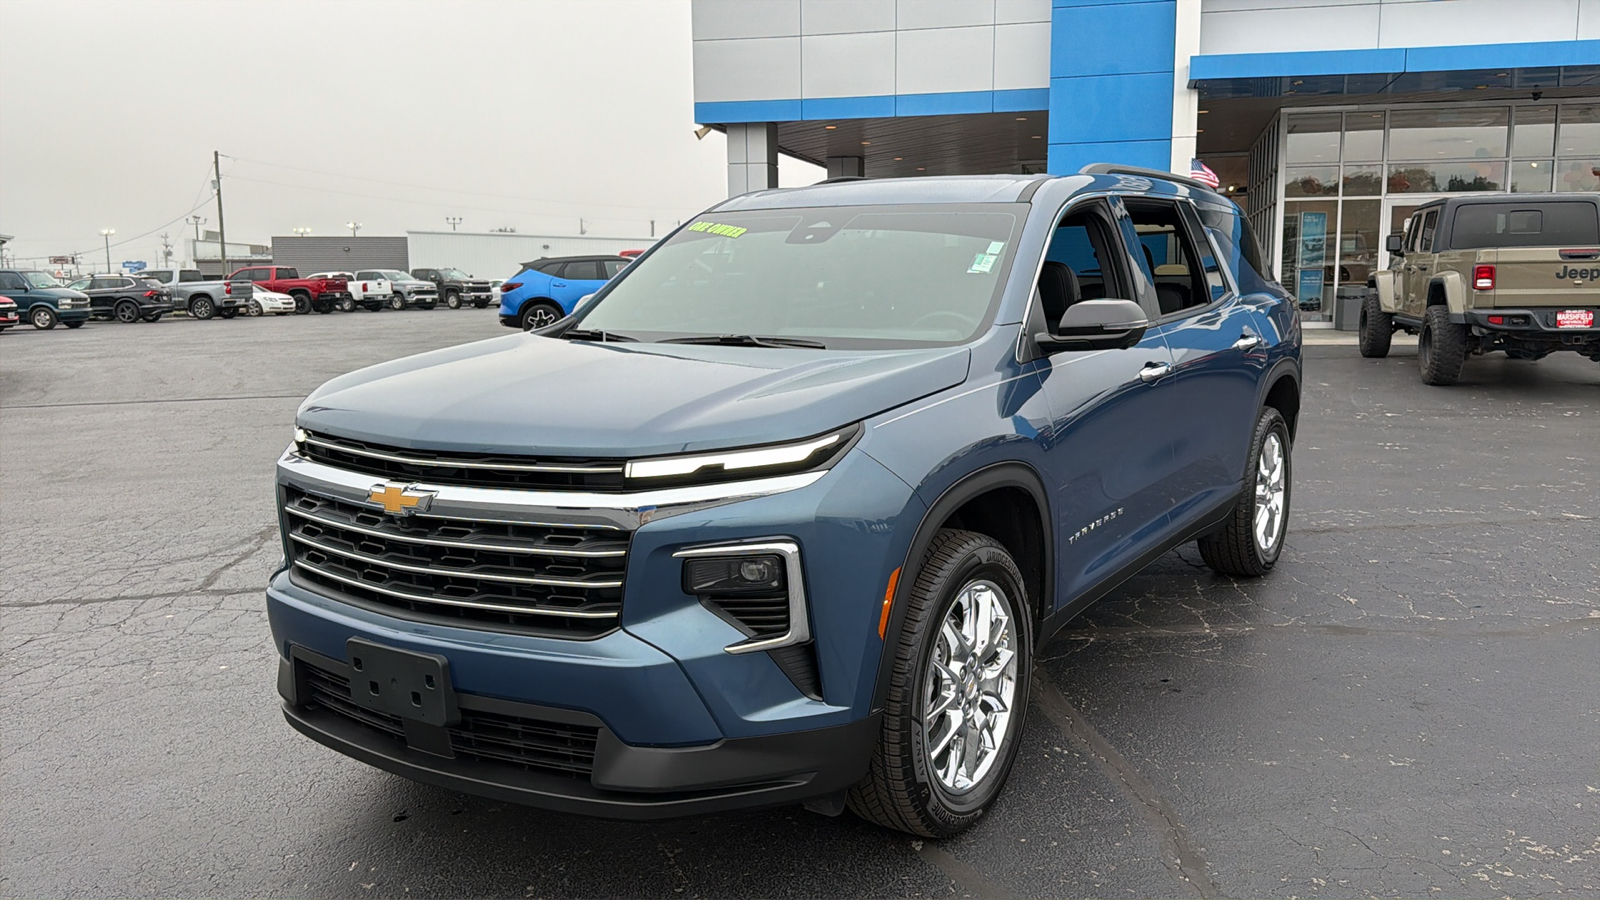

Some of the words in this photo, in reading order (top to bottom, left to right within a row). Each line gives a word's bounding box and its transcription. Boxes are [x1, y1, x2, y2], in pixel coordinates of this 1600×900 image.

[688, 221, 714, 232] ONE
[707, 223, 747, 239] OWNER
[1556, 265, 1600, 281] Jeep
[1068, 507, 1124, 544] TRAVERSE
[986, 550, 1023, 585] BRIDGESTONE
[914, 730, 925, 776] ALENZA
